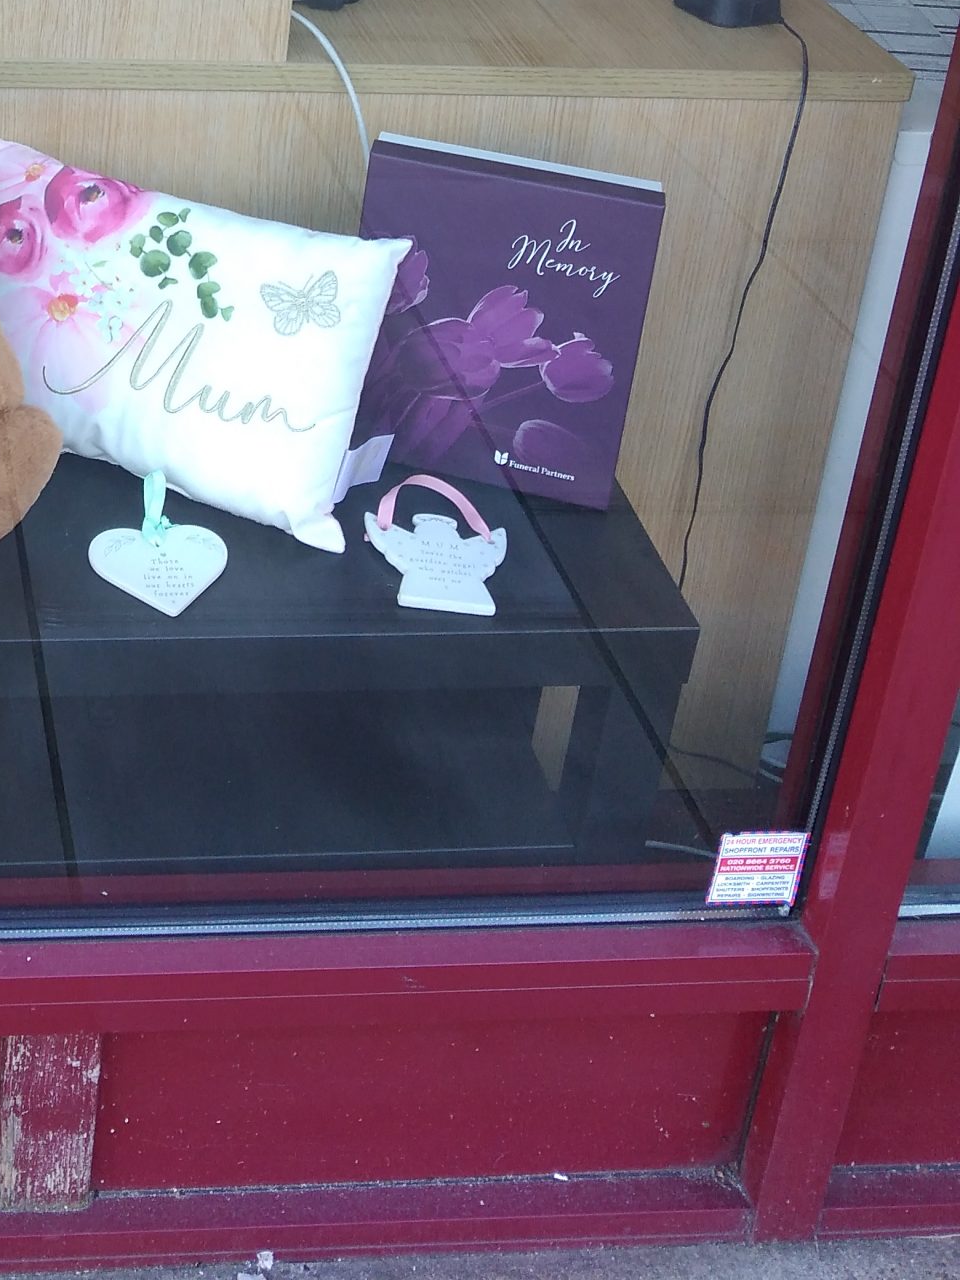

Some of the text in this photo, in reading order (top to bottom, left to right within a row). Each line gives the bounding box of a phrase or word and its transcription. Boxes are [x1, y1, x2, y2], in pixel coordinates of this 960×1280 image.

[556, 219, 591, 253] In
[507, 234, 621, 298] Memory
[42, 298, 316, 433] Mum
[508, 459, 575, 482] Funeral Partners
[166, 580, 195, 589] hearts
[724, 845, 801, 854] SHOPFRONT REPAIRS
[758, 836, 803, 845] EMERGENCY
